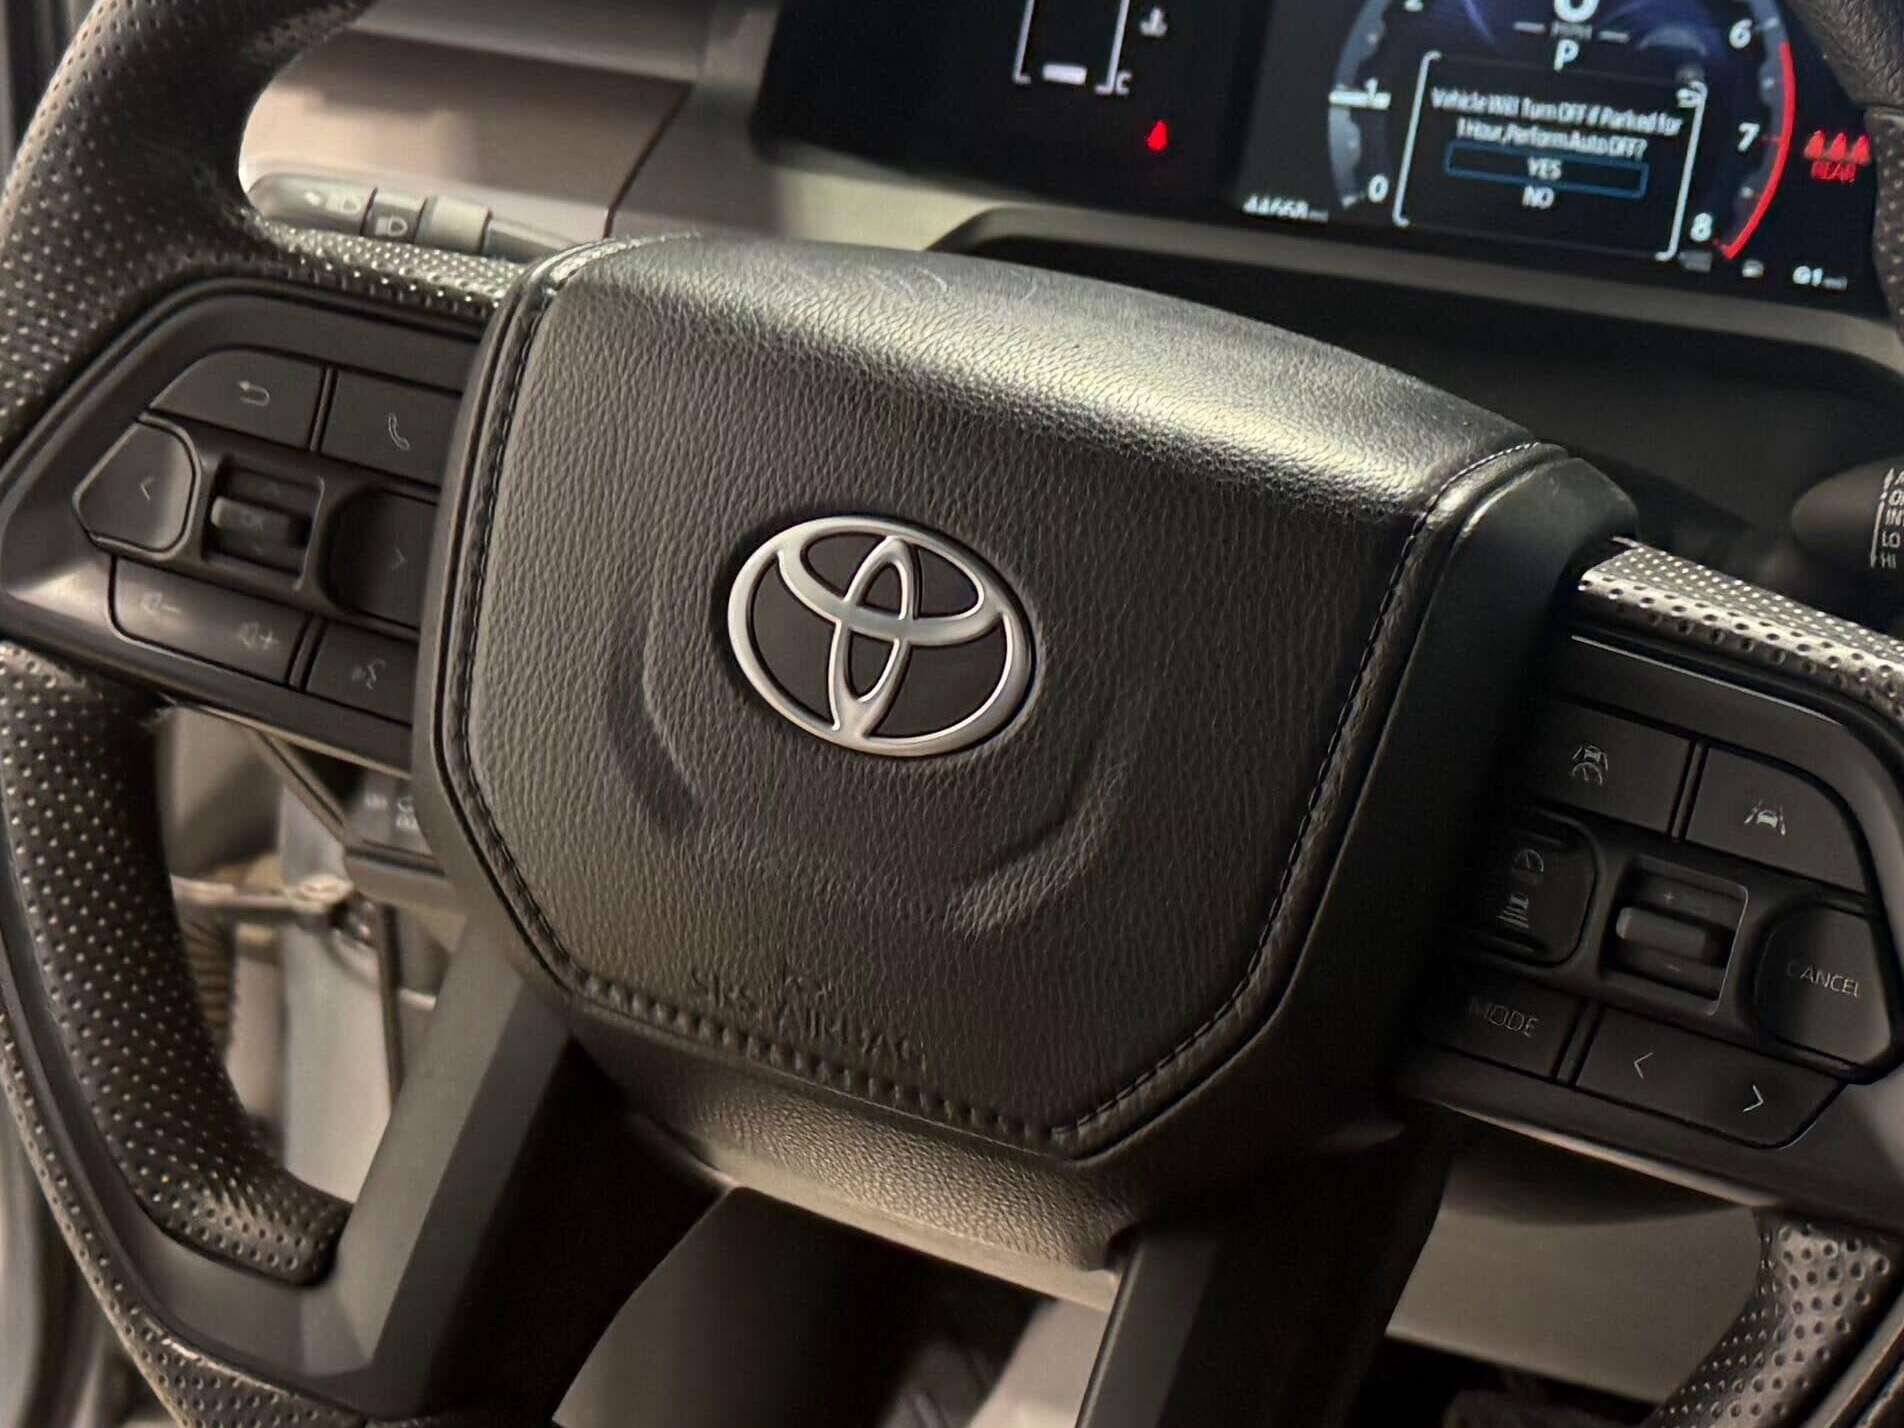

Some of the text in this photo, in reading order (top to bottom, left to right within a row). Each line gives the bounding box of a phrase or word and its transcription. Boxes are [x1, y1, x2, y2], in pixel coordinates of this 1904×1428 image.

[1729, 20, 1752, 48] 6
[1553, 38, 1580, 71] P
[1737, 122, 1761, 152] 7
[1527, 155, 1562, 181] YES
[1368, 174, 1389, 203] 0
[1521, 184, 1556, 210] NO
[1689, 212, 1713, 242] 8
[1882, 531, 1901, 549] LO
[1880, 552, 1897, 570] HI
[1786, 962, 1861, 999] CANCEL
[1469, 995, 1541, 1038] MODE
